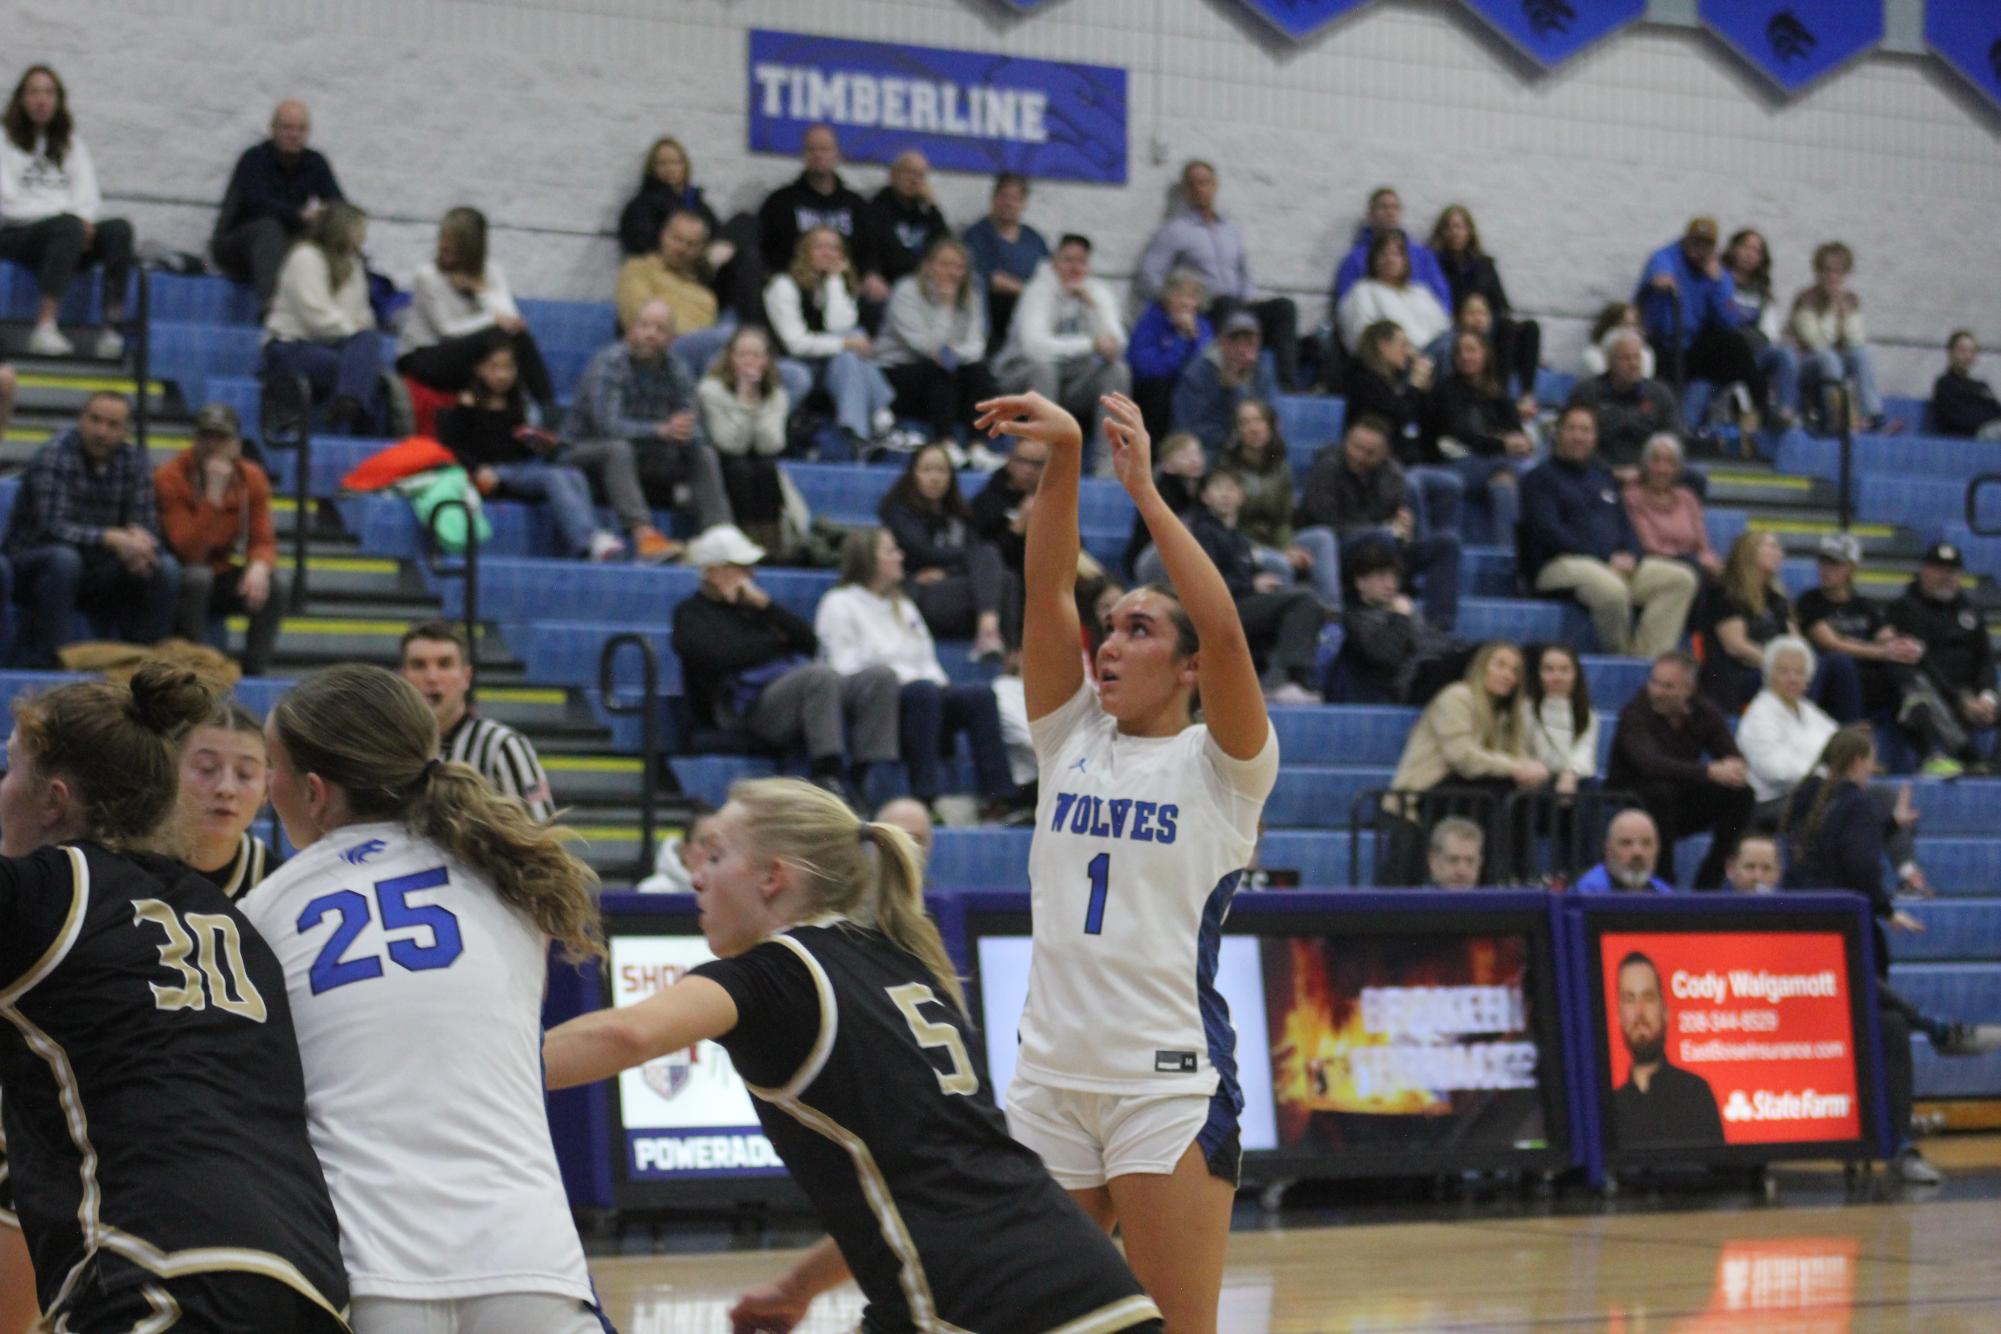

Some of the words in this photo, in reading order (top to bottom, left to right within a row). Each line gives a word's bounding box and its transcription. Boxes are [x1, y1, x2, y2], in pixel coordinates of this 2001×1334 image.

[755, 64, 1048, 143] TIMBERLINE
[1051, 792, 1179, 845] WOLVES
[296, 866, 465, 996] 25
[1084, 852, 1111, 935] 1
[130, 898, 268, 1024] 30
[1671, 970, 1726, 1004] Cody
[883, 981, 980, 1096] 5
